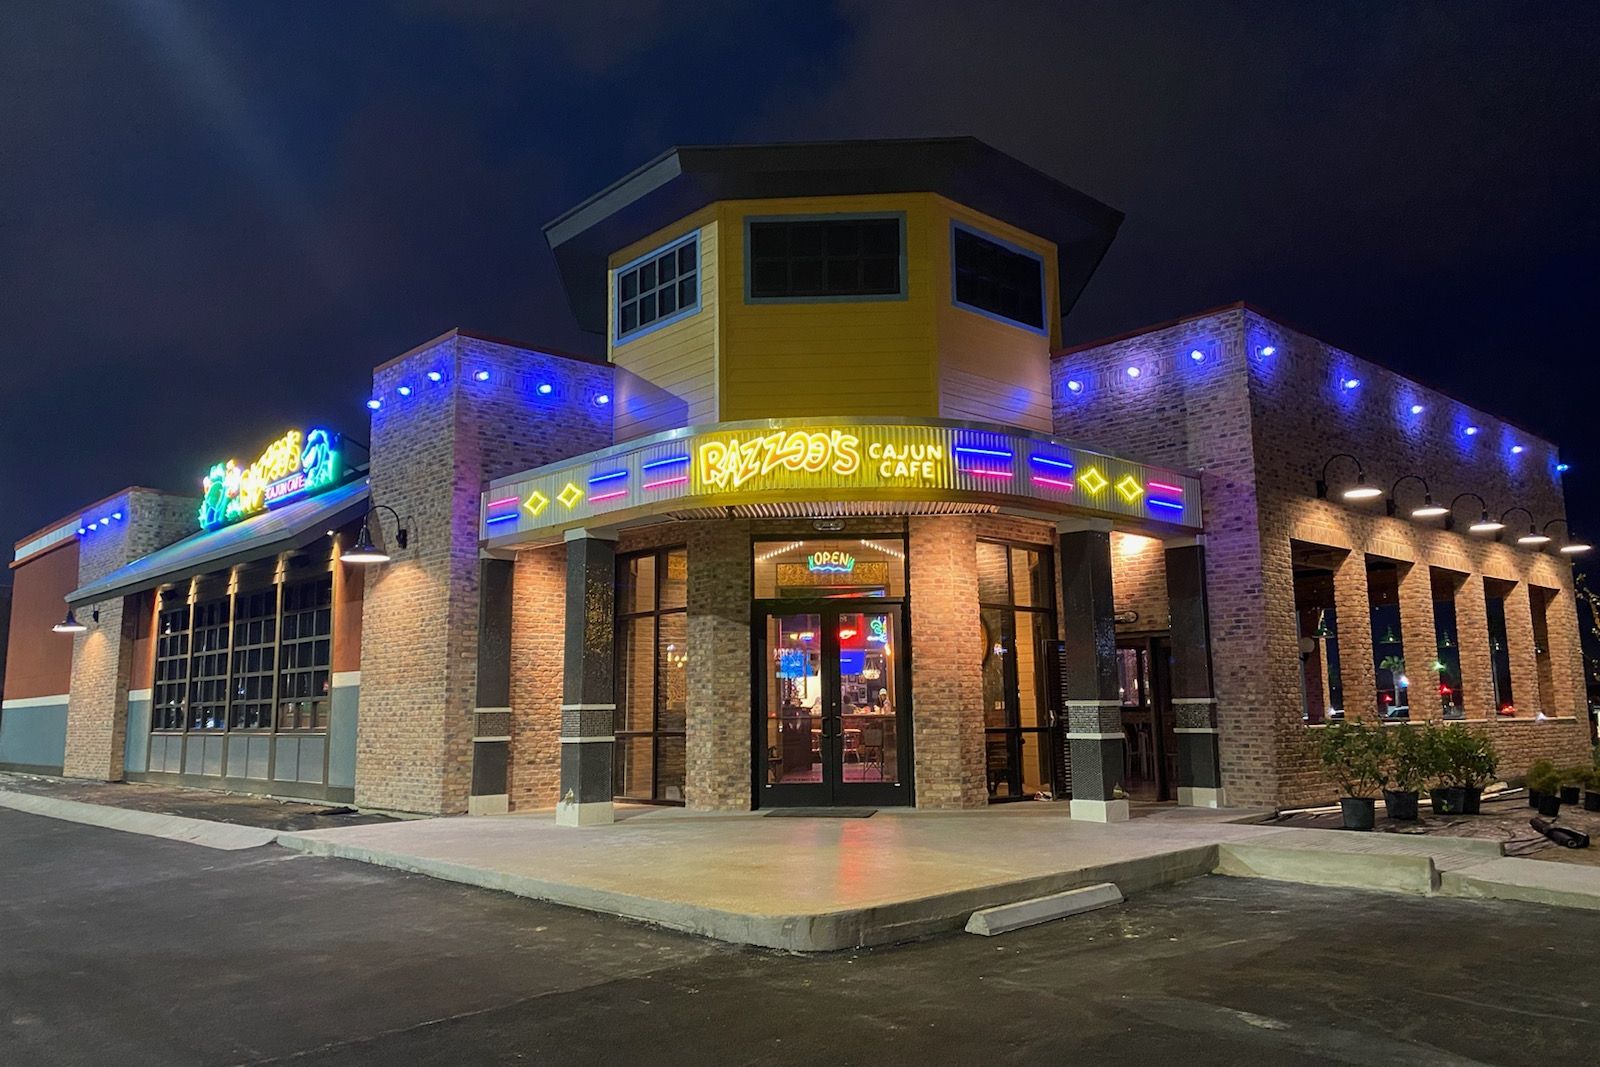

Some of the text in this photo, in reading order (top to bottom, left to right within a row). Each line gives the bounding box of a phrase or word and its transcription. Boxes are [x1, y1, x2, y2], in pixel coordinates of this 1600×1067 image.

[699, 430, 861, 488] RAZZOO'S
[868, 443, 943, 460] CAJUN
[880, 461, 934, 478] CAFE
[813, 551, 850, 566] OPEN
